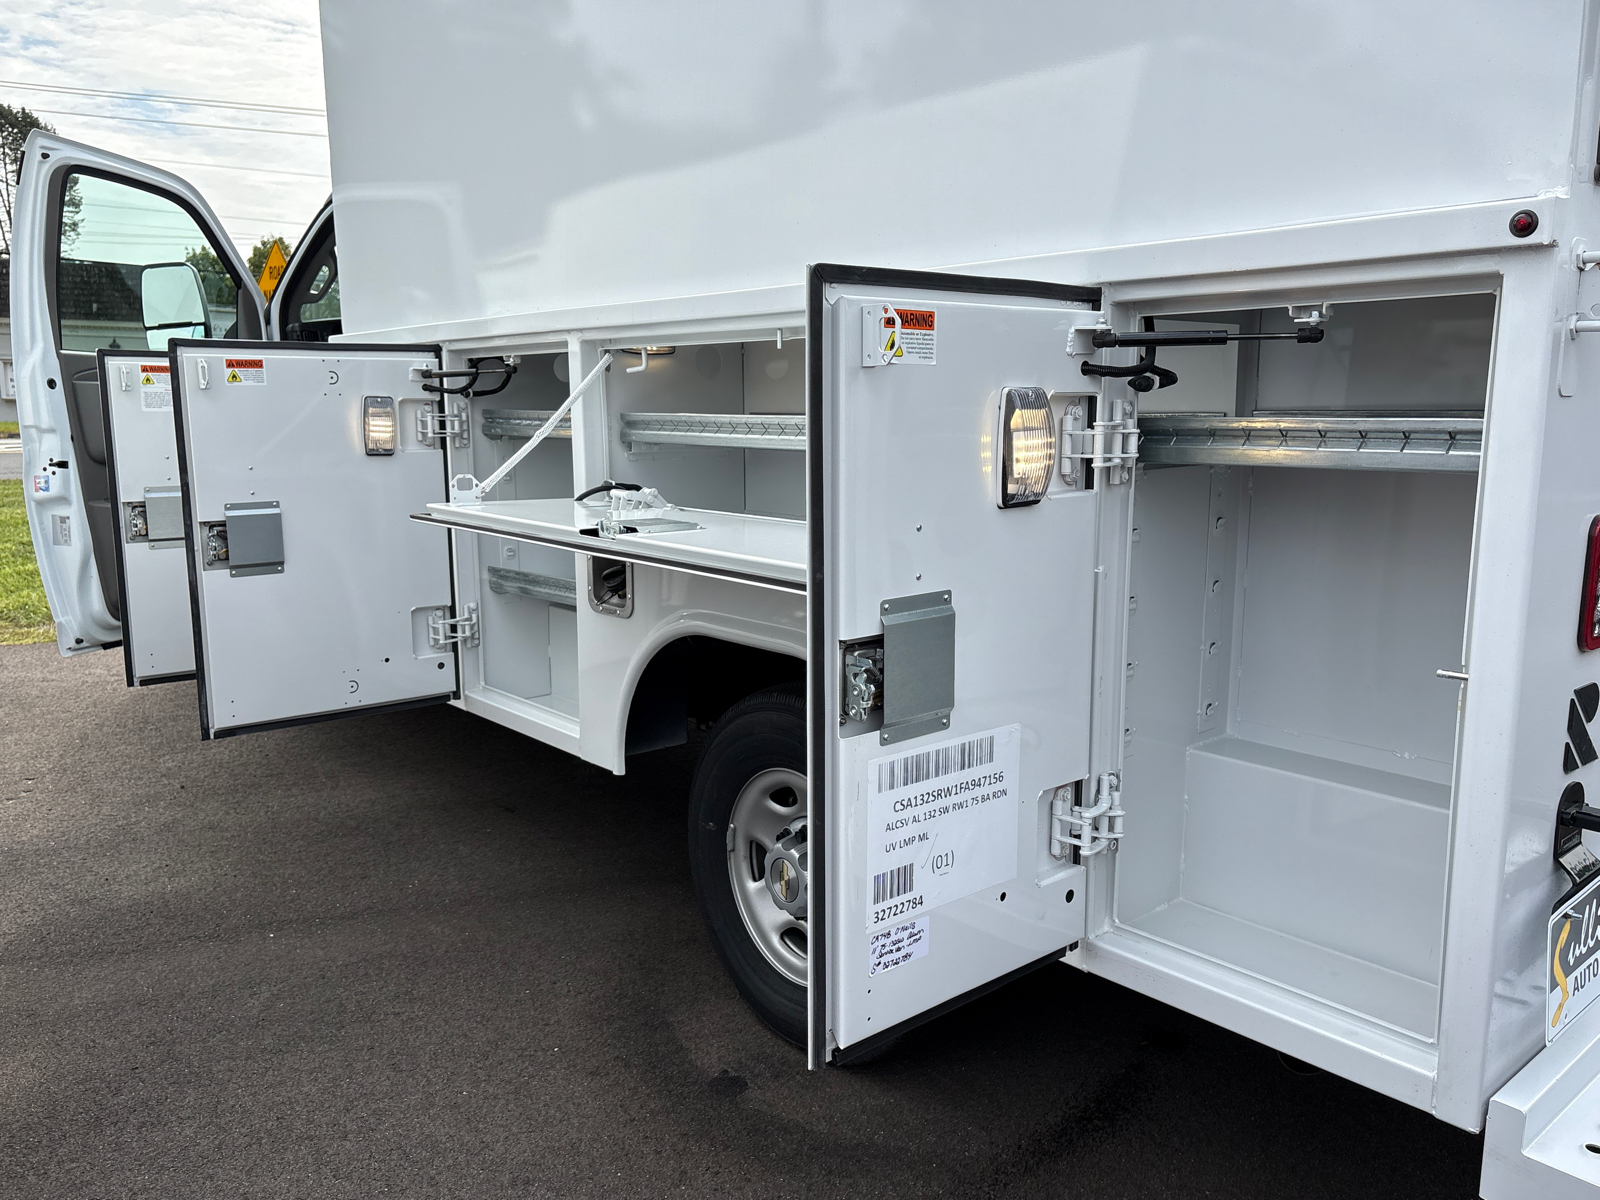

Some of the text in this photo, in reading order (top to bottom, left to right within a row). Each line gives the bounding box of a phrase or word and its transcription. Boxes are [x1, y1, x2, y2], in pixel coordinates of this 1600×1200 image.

[269, 265, 284, 280] ROA
[235, 359, 263, 368] WARNING
[893, 771, 1004, 813] CSA132SRW1FA947156
[885, 788, 1008, 833] ALCSV AL 132 SW RW1 75 BA RDN
[885, 832, 930, 853] UV LMP ML
[931, 850, 955, 874] (01)
[873, 895, 924, 924] 32722784
